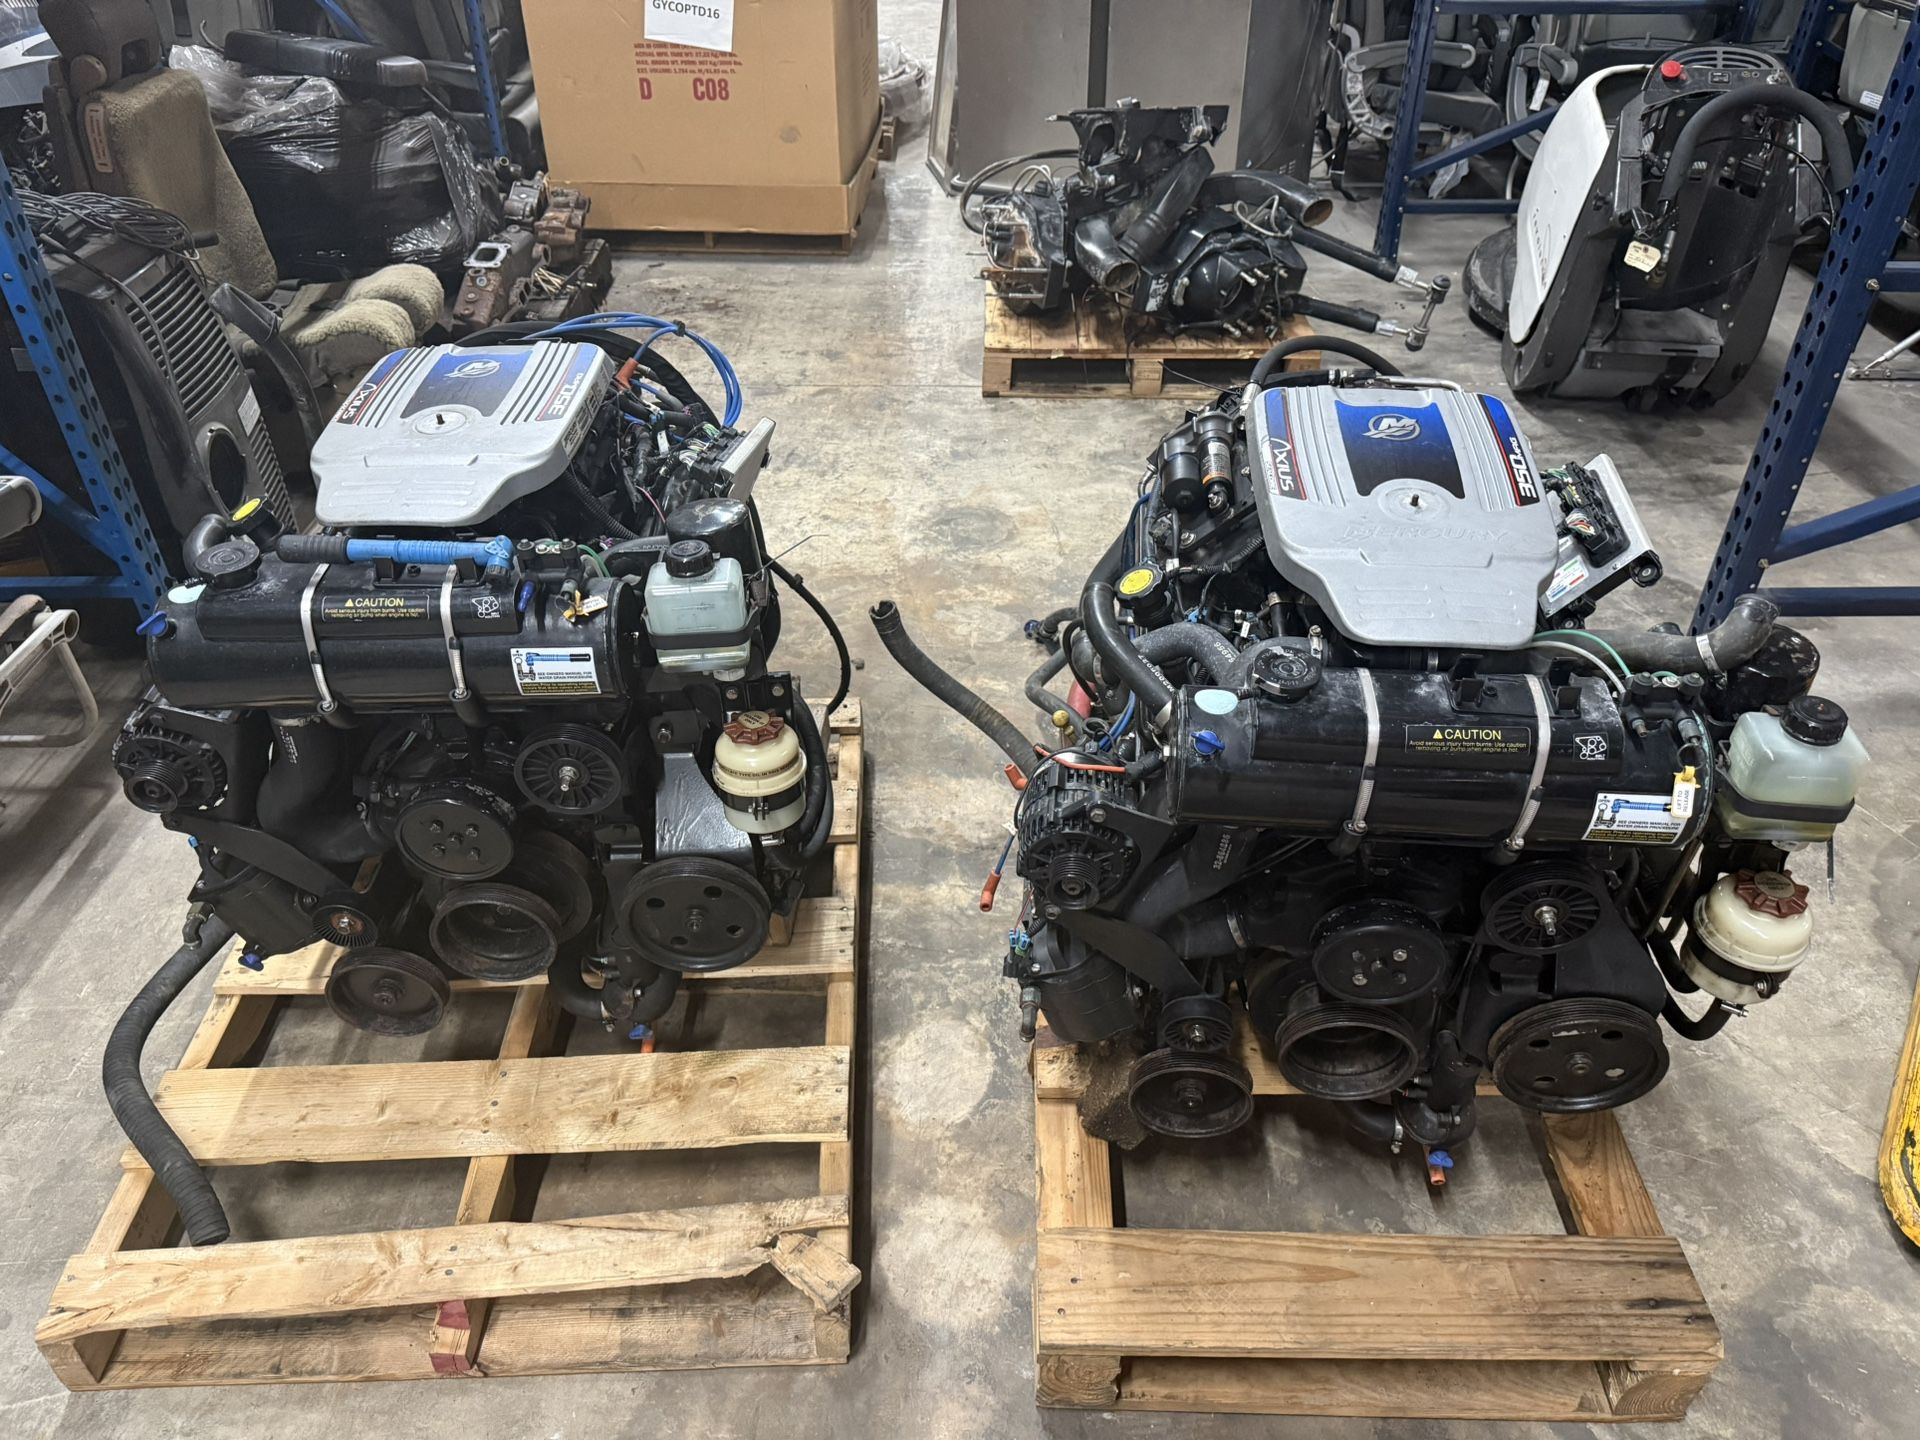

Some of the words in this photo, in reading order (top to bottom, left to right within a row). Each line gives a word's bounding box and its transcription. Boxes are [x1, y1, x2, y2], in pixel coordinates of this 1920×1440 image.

[652, 0, 720, 19] GYCOPTD16
[639, 77, 652, 100] D
[693, 77, 729, 101] C08
[342, 382, 377, 419] AXIUS
[548, 384, 576, 415] 350
[1270, 438, 1294, 491] AXIUS
[1509, 454, 1537, 498] 350
[355, 598, 404, 607] CAUTION
[1445, 729, 1501, 740] CAUTION
